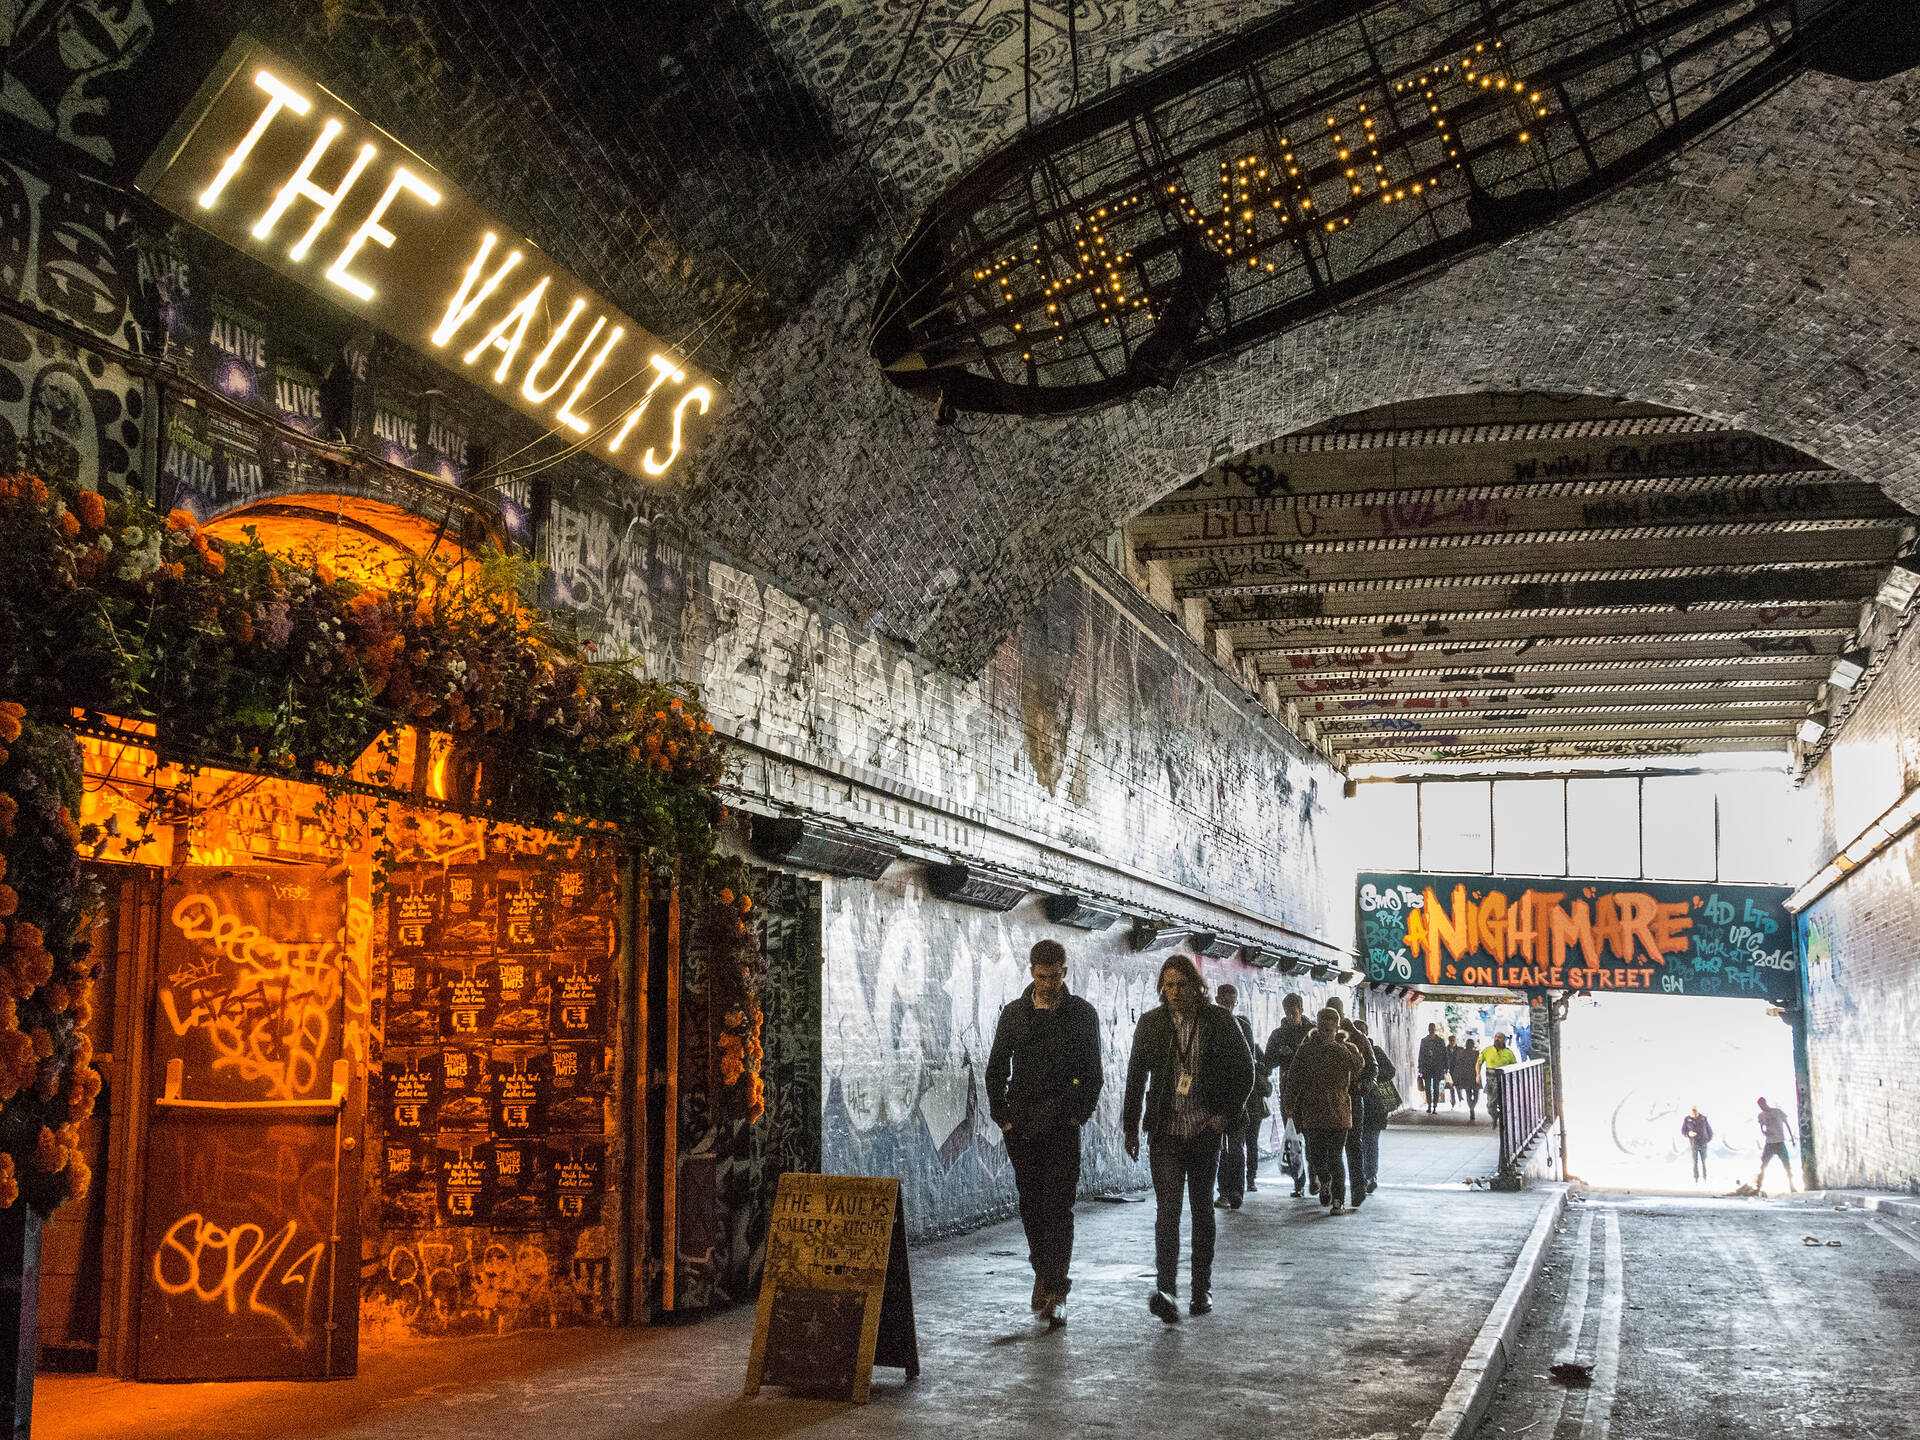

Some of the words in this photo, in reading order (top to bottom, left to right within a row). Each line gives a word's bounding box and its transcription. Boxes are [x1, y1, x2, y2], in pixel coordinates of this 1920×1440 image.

[199, 70, 442, 301] THE
[431, 231, 713, 474] VAULTS
[209, 318, 266, 369] ALIVE
[275, 378, 322, 419] ALIVE
[373, 409, 418, 451] ALIVE
[1421, 883, 1693, 984] NIGHTMARE
[1462, 965, 1493, 985] ON
[1498, 966, 1564, 987] LEAKE
[1567, 967, 1655, 989] STREET
[1751, 949, 1795, 972] 2016
[781, 1192, 812, 1214] THE
[824, 1194, 890, 1217] VAULTS
[776, 1217, 832, 1234] GALLERY
[843, 1219, 887, 1238] KITCHEN
